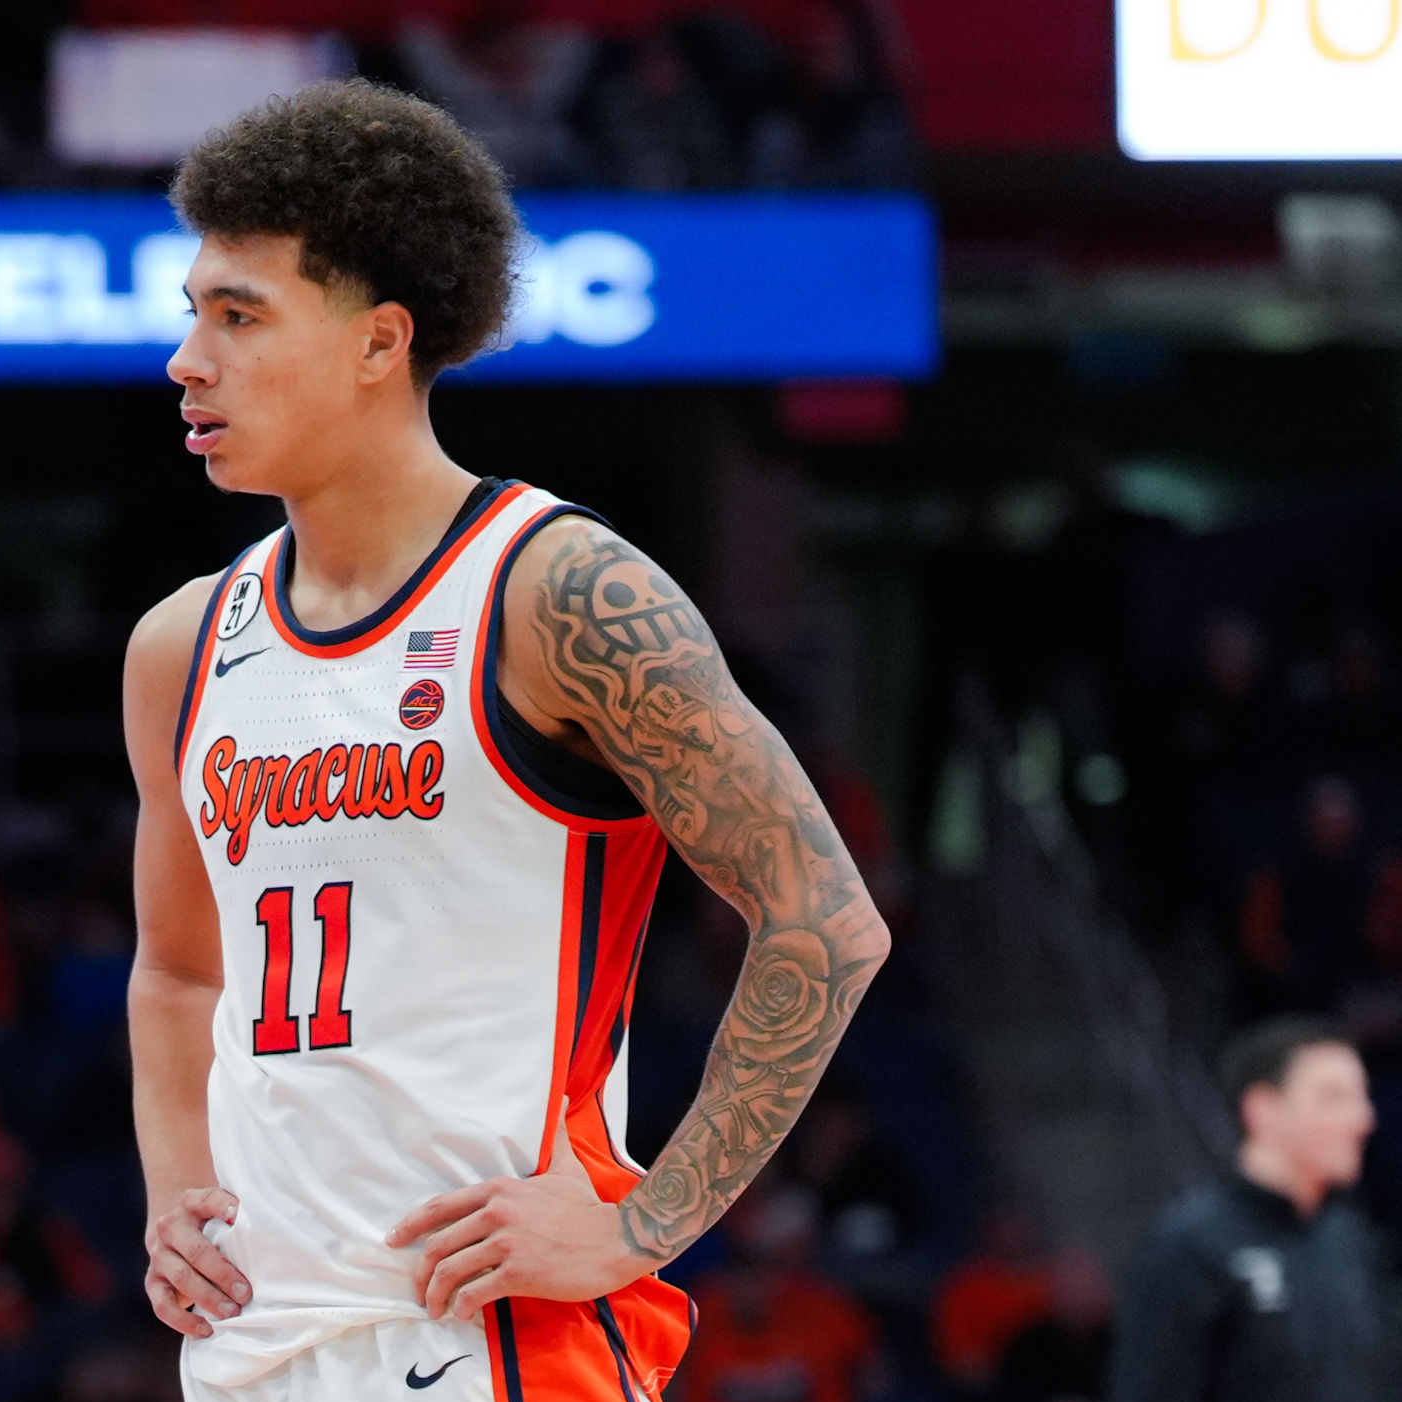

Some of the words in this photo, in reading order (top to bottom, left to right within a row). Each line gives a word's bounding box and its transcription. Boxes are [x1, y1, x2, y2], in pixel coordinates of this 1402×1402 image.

[233, 580, 251, 602] LM
[224, 602, 244, 631] 21
[406, 695, 442, 707] ACC
[199, 736, 445, 867] Syracuse
[253, 881, 353, 1056] 11
